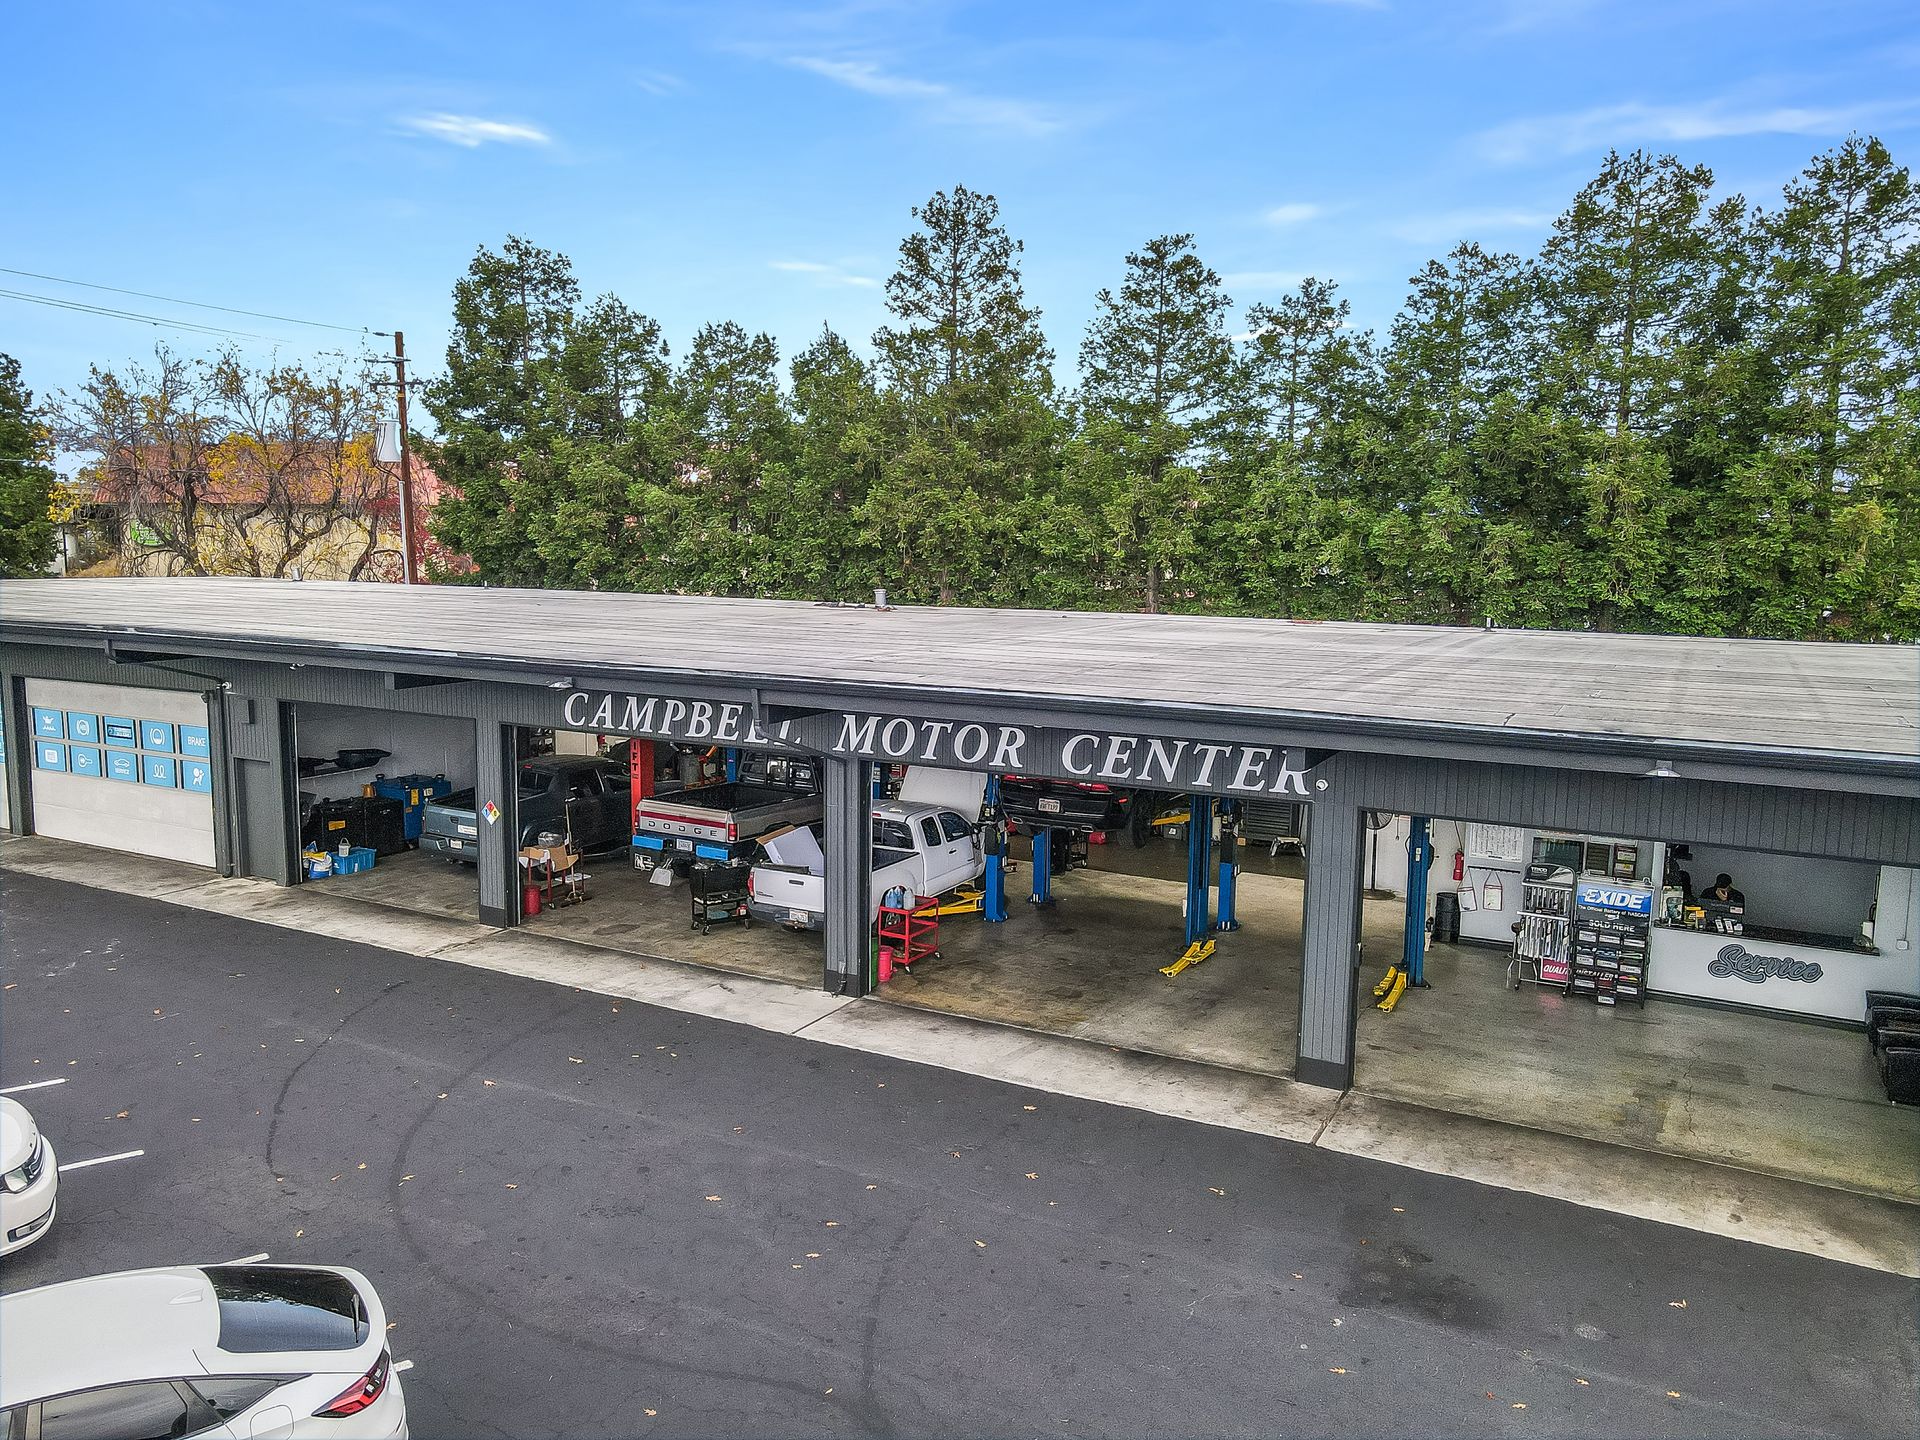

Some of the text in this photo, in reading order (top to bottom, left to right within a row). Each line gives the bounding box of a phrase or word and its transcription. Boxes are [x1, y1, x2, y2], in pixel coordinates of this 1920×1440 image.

[187, 736, 206, 747] BRAKE
[832, 714, 1026, 768] MOTOR
[1061, 734, 1311, 795] CENTER
[648, 820, 718, 837] DODGE
[1583, 888, 1645, 910] EXIDE
[1588, 919, 1635, 933] SOLD HERE
[1707, 943, 1824, 984] Service
